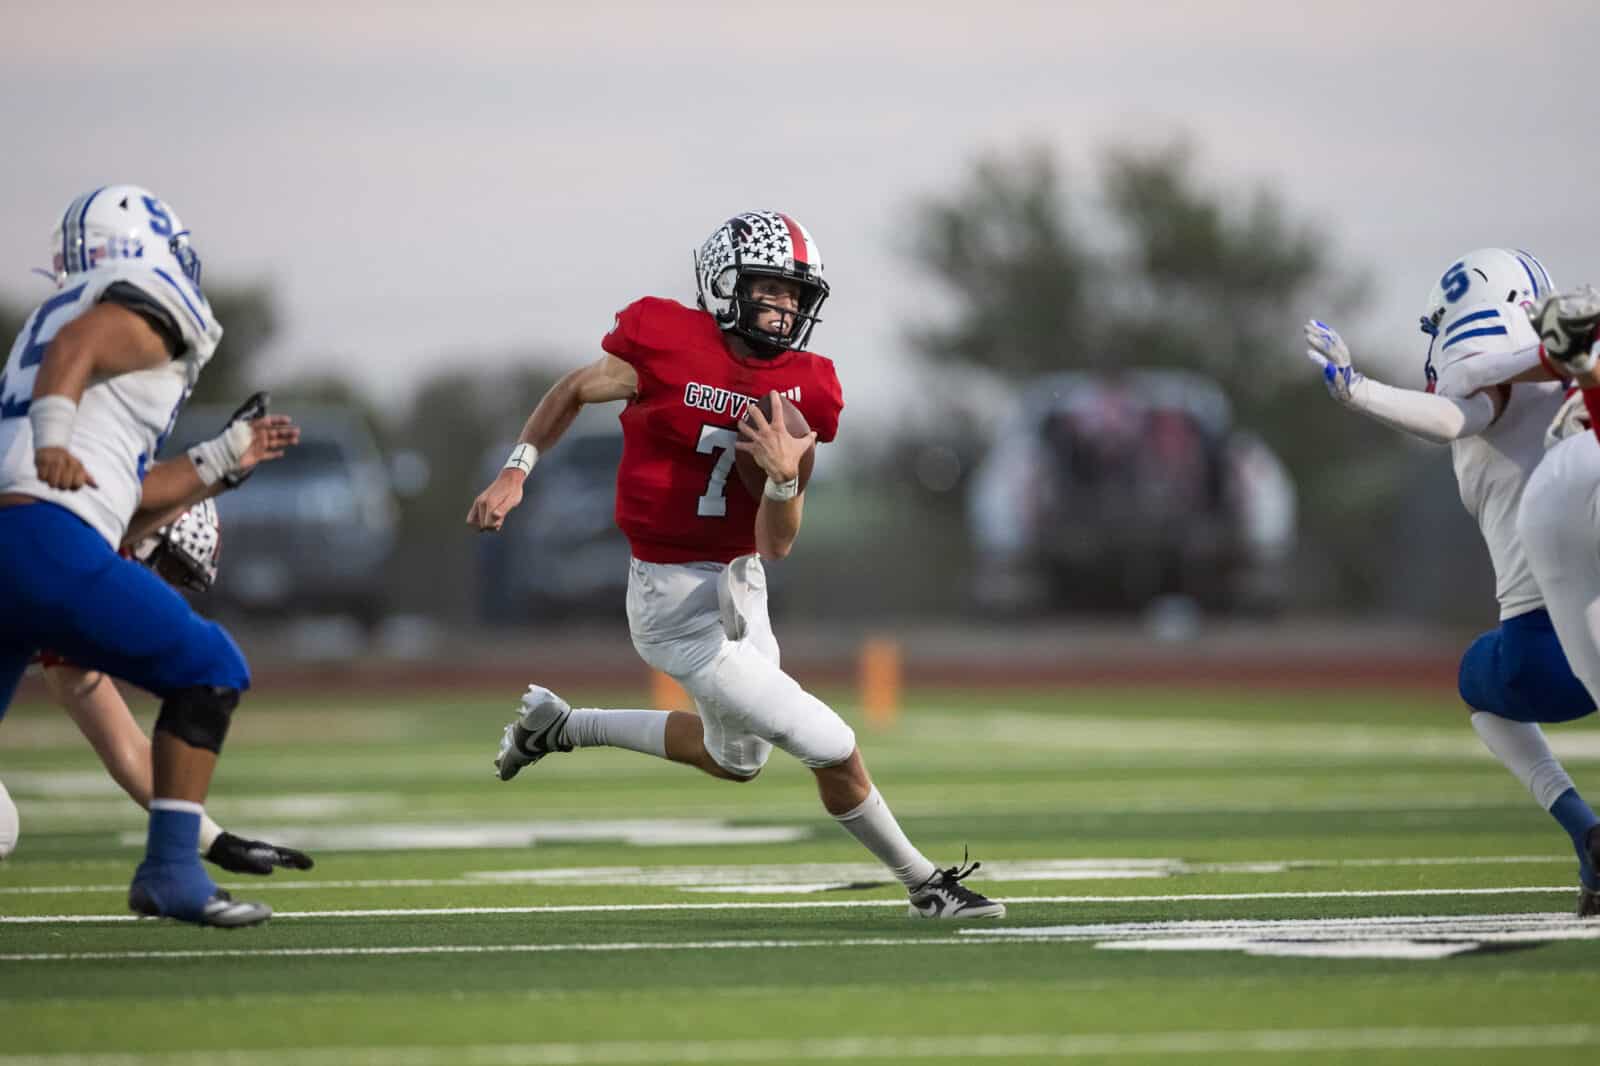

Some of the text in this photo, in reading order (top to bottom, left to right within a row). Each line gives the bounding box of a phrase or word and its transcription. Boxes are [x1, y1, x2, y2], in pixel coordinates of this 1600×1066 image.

[141, 195, 172, 237] S
[1441, 262, 1470, 304] S
[696, 424, 737, 517] 7
